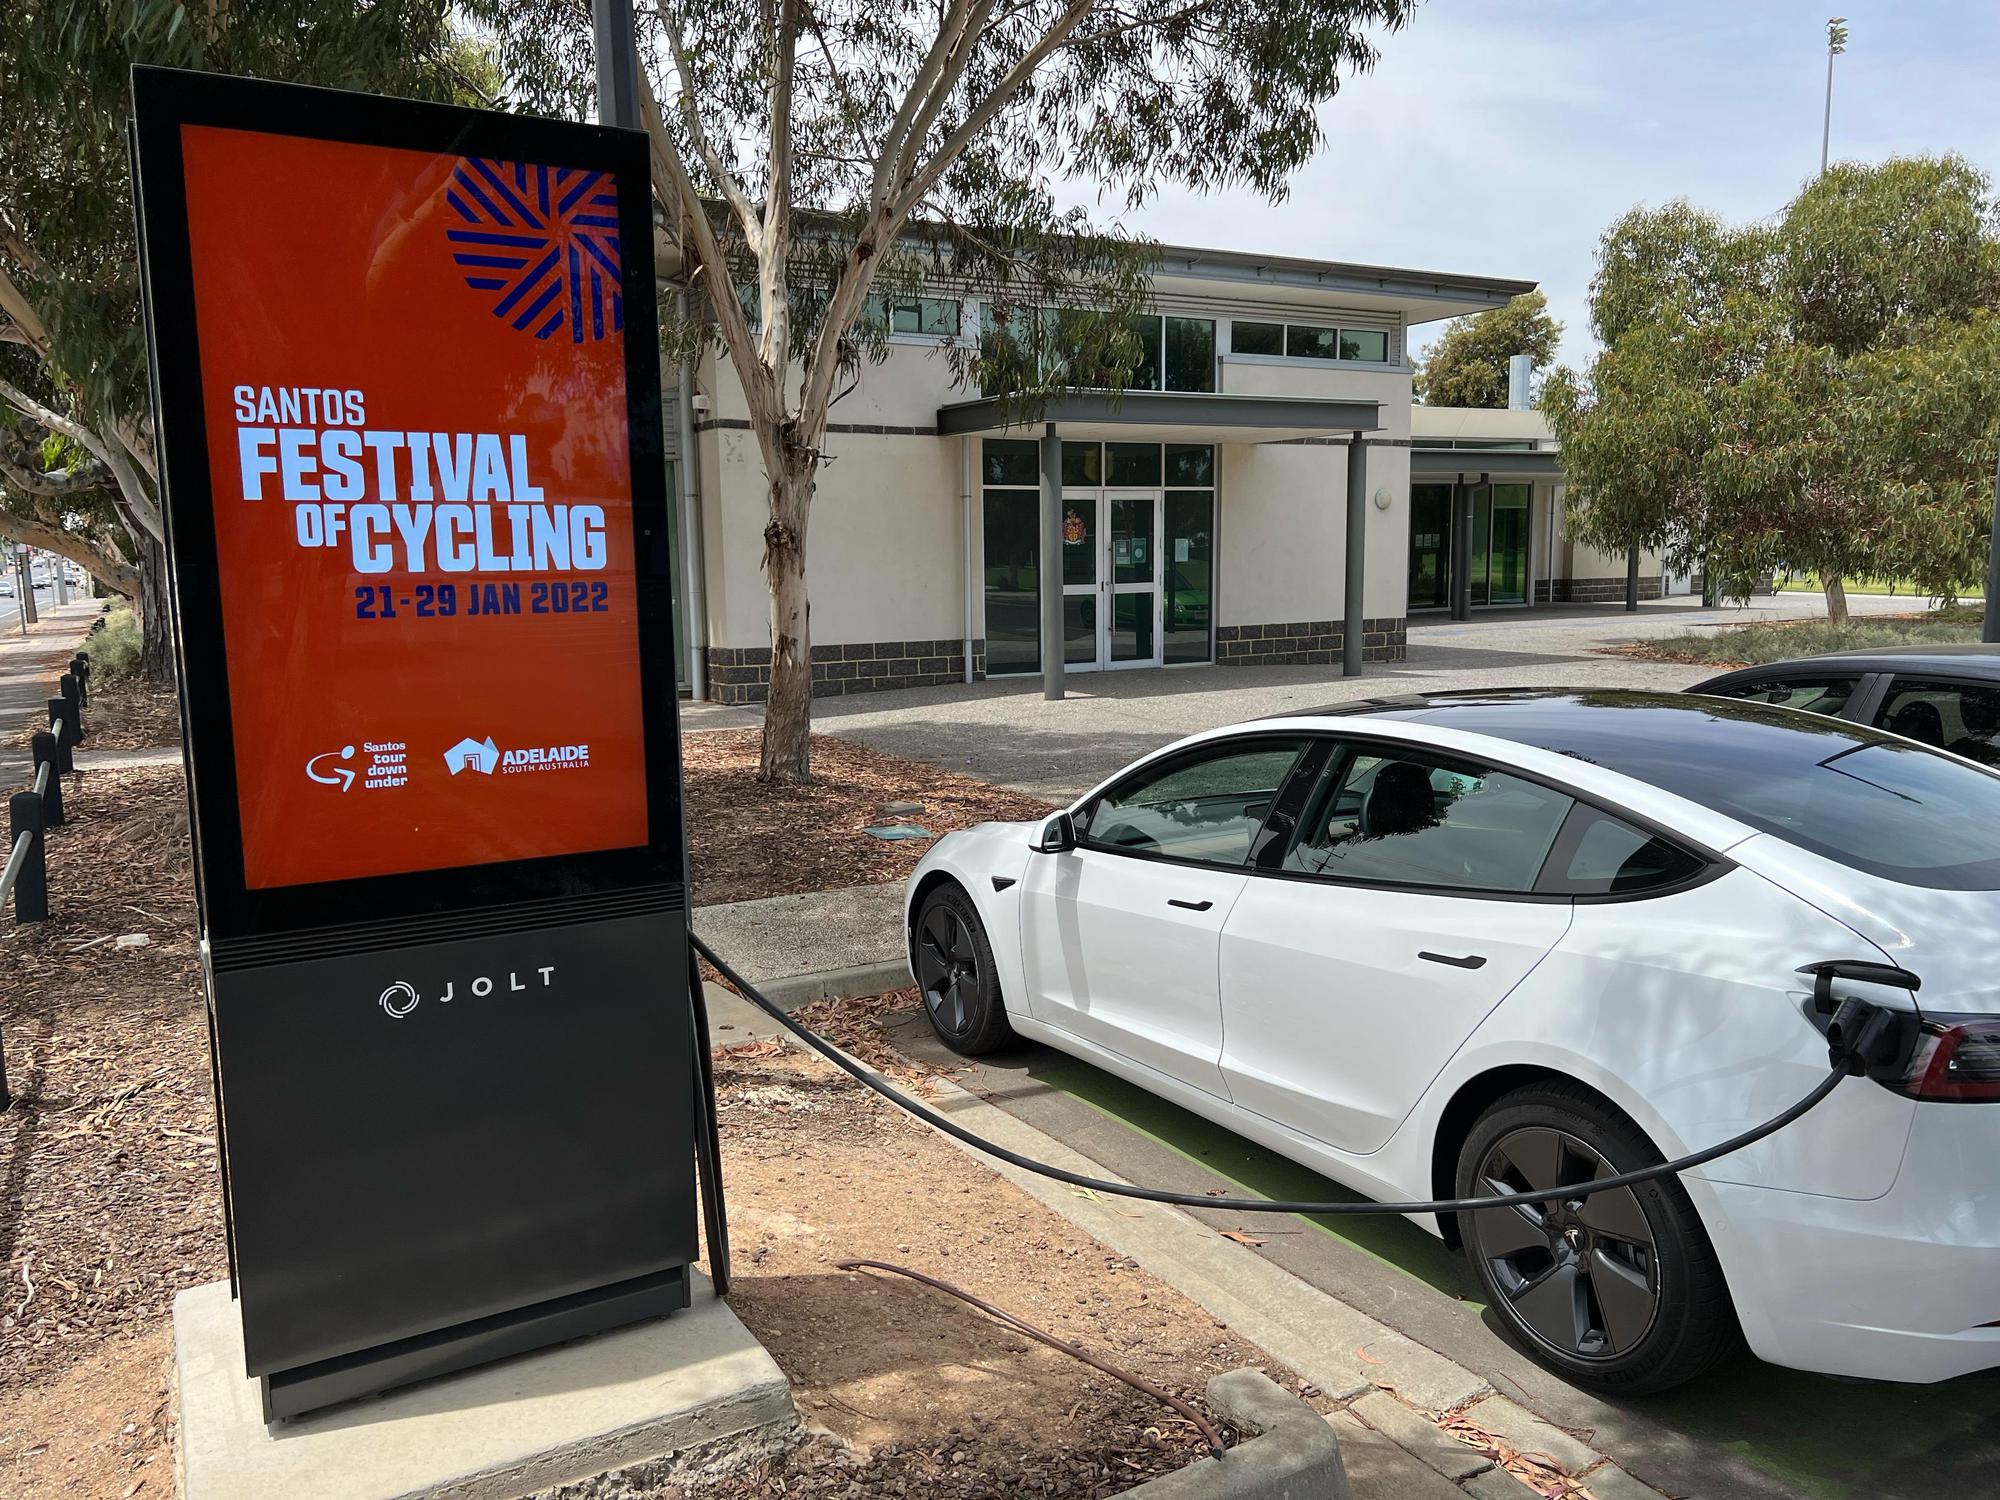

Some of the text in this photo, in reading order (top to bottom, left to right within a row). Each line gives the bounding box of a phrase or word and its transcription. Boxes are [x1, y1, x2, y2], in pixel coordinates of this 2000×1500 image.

[233, 385, 366, 426] SANTOS
[237, 427, 545, 502] FESTIVAL
[295, 503, 608, 574] OF CYCLING
[355, 582, 609, 619] 21-29 JAN 2022
[363, 741, 406, 752] Santos
[502, 745, 589, 766] ADELAIDE
[373, 753, 407, 764] tour
[502, 760, 590, 774] SOUTH AUSTRALIA
[367, 764, 407, 776] down
[364, 775, 408, 788] under
[439, 966, 555, 1003] JOLT
